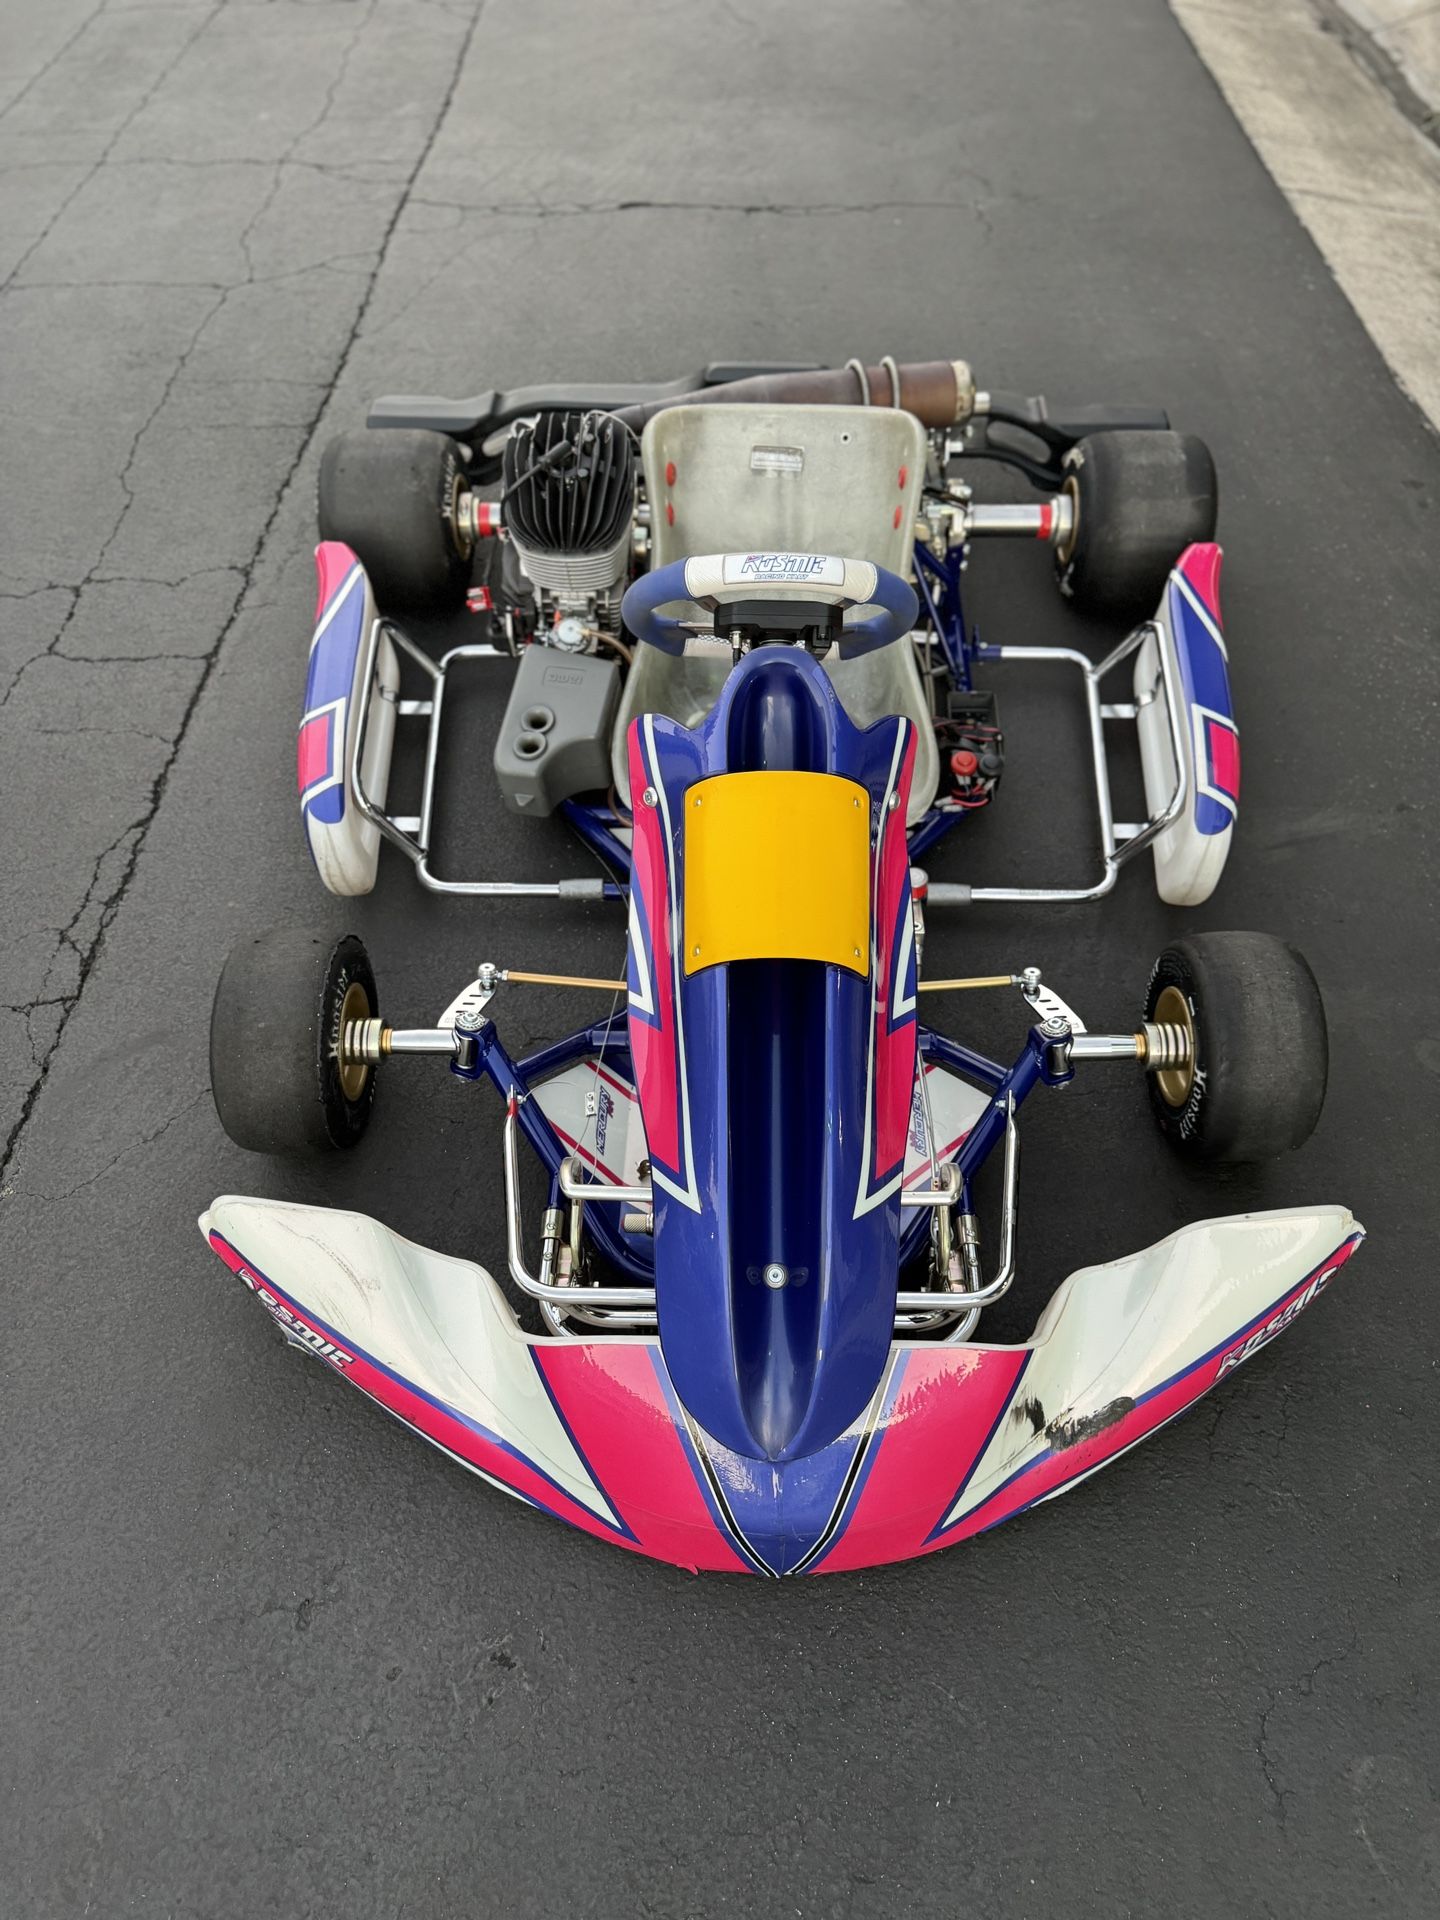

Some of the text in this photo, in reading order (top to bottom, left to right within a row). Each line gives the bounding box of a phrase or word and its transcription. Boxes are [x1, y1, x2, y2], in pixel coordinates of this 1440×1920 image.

[741, 555, 827, 574] KOSMIC
[596, 1085, 611, 1156] MERCURY
[912, 1091, 928, 1157] MERCURY
[238, 1266, 357, 1369] KOSMIC
